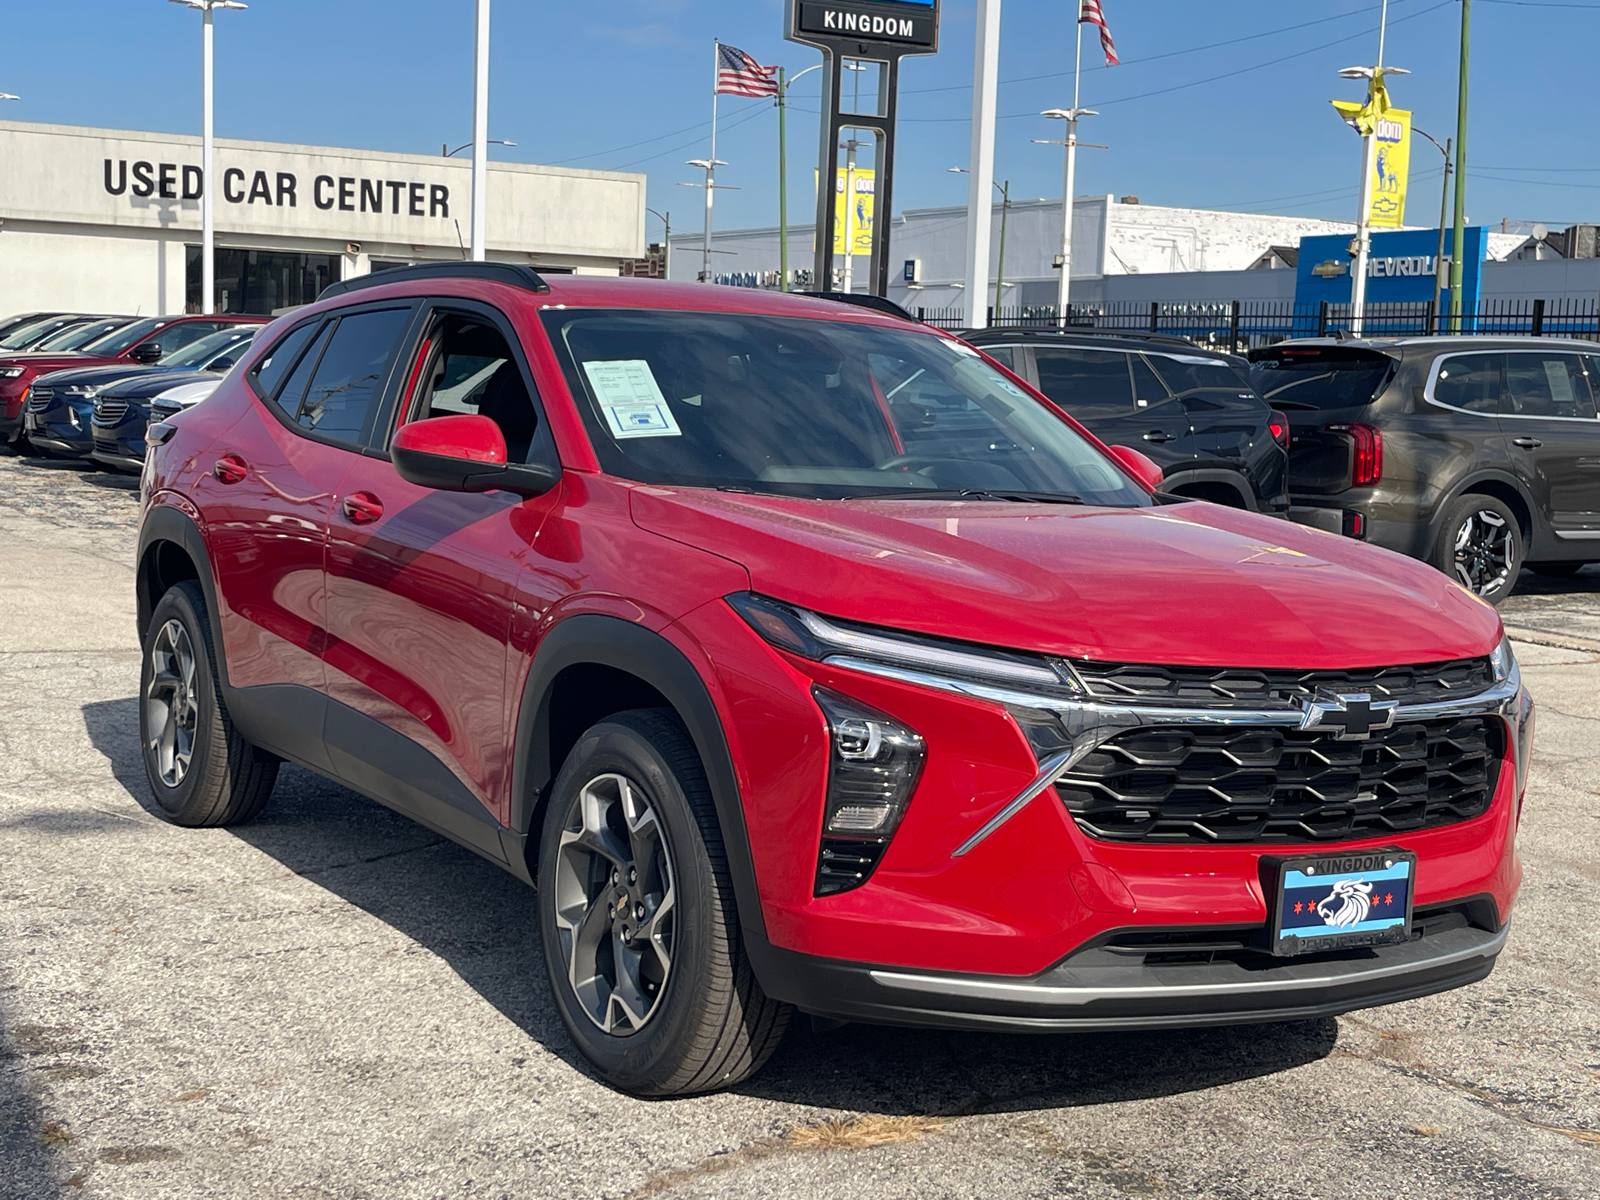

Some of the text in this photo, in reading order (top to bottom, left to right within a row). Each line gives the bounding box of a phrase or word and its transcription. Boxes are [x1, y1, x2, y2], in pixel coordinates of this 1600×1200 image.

[823, 10, 913, 37] KINGDOM
[1377, 117, 1402, 141] dom
[104, 158, 450, 218] USED CAR CENTER
[1315, 855, 1386, 873] KINGDOM
